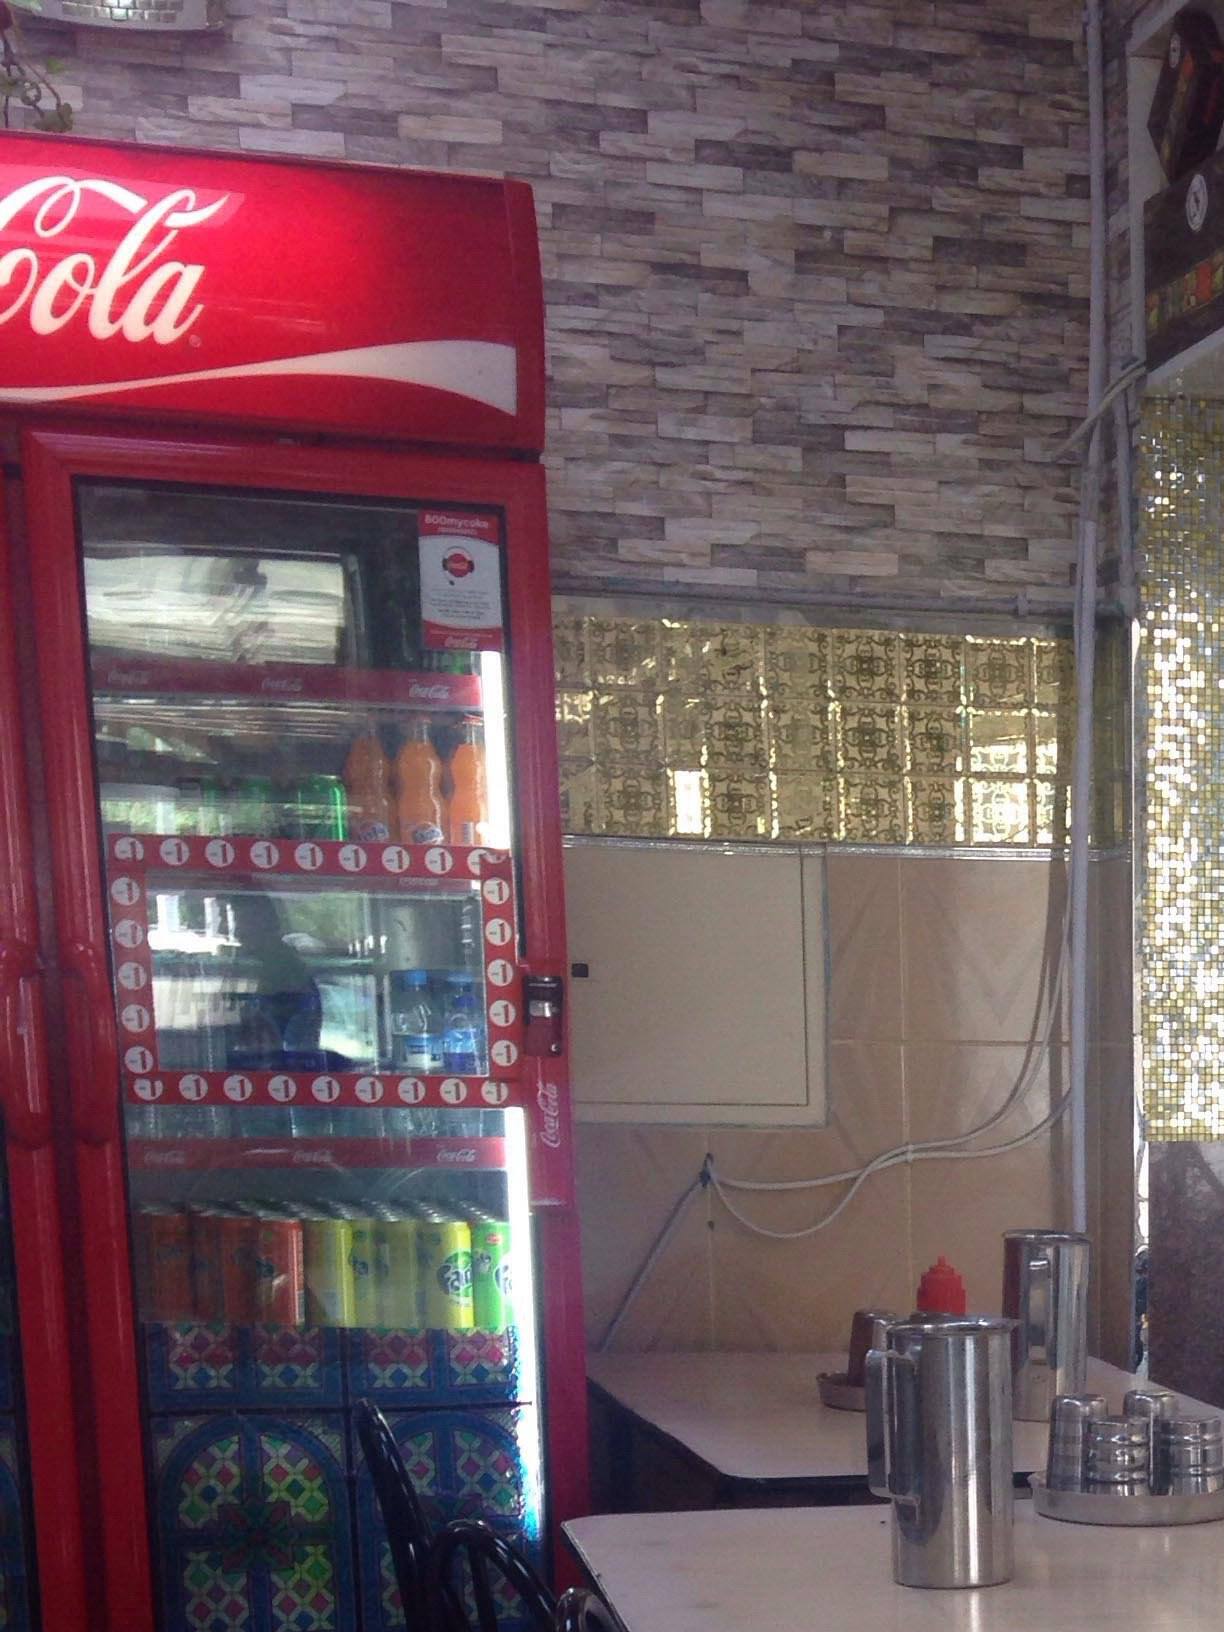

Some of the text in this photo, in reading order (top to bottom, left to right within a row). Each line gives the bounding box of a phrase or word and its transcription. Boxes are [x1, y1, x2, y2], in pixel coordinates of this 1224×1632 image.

[175, 842, 183, 863] 1
[220, 843, 228, 864] 1
[266, 844, 272, 866] 1
[310, 847, 317, 867] 1
[354, 847, 360, 868] 1
[396, 850, 403, 870] 1
[439, 851, 446, 871] 1
[497, 880, 503, 901] 1
[500, 922, 506, 942] 1
[501, 963, 507, 984] 1
[136, 1008, 143, 1029] 1
[503, 1003, 509, 1024] 1
[140, 1050, 147, 1070] 1
[504, 1044, 512, 1064] 1
[192, 1077, 200, 1098] 1
[239, 1078, 246, 1098] 1
[282, 1078, 290, 1099] 1
[326, 1080, 333, 1100] 1
[371, 1080, 377, 1100] 1
[411, 1081, 419, 1101] 1
[455, 1081, 461, 1101] 1
